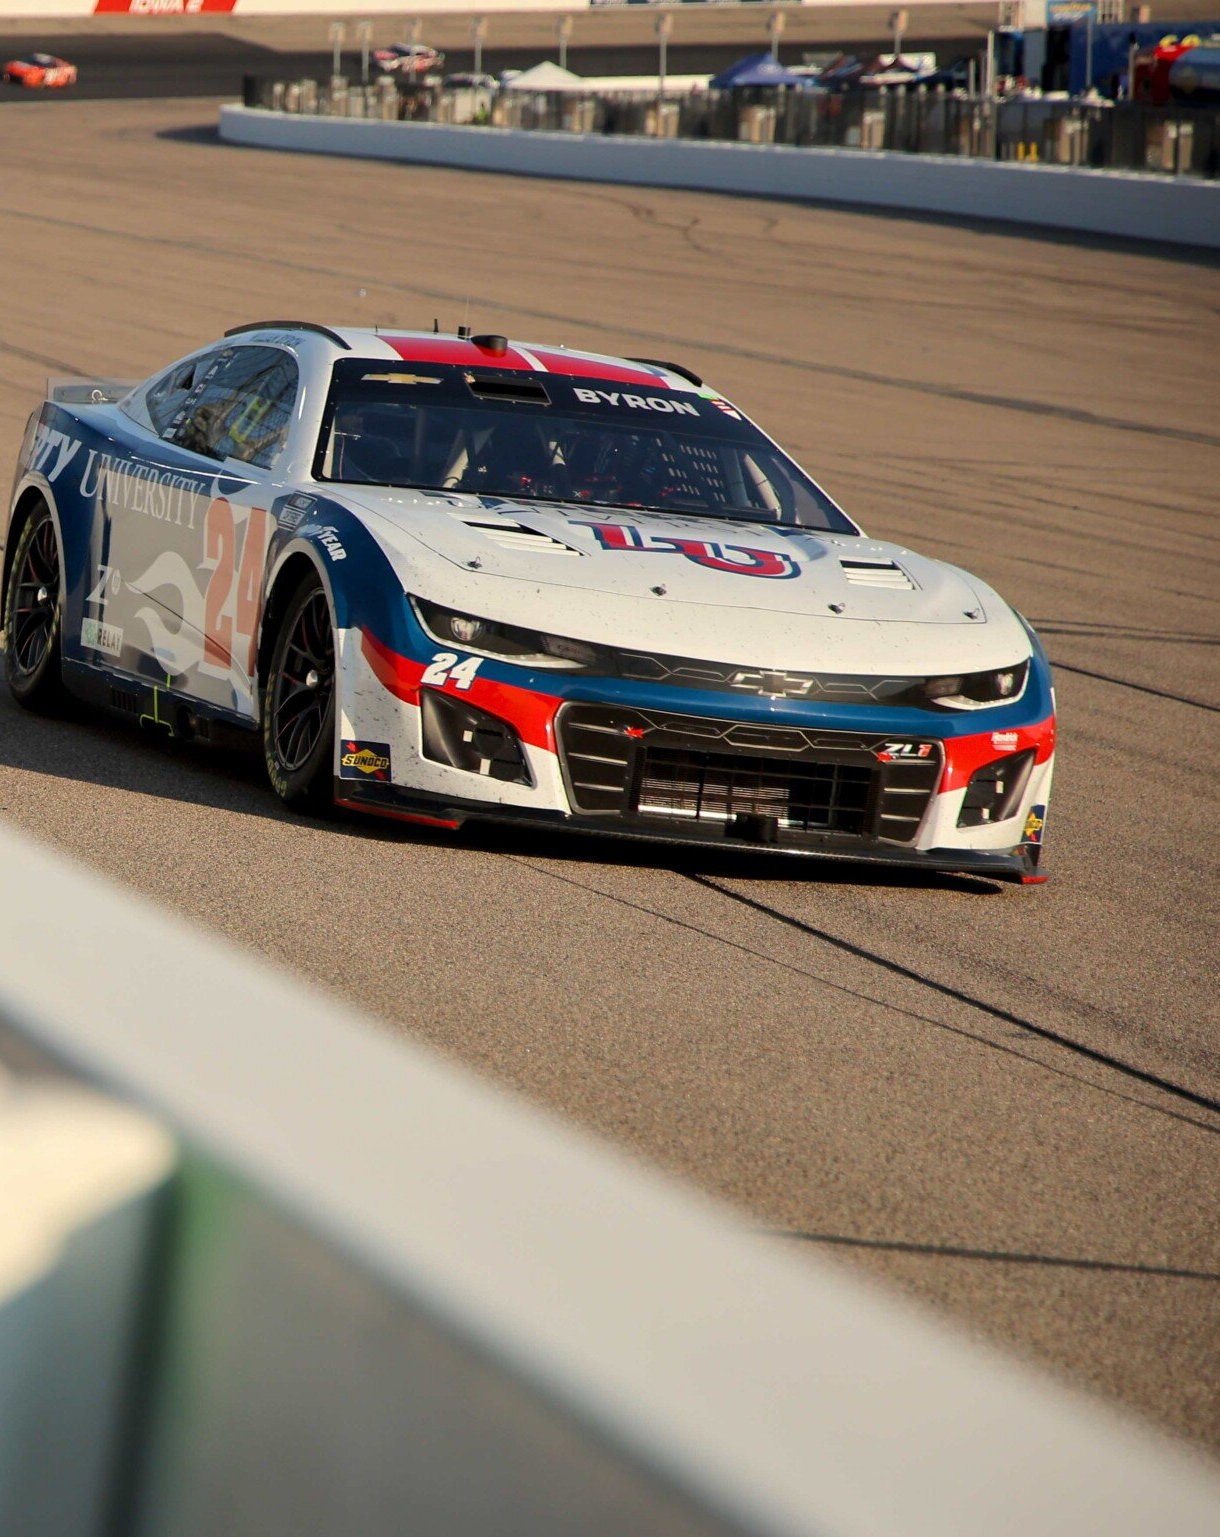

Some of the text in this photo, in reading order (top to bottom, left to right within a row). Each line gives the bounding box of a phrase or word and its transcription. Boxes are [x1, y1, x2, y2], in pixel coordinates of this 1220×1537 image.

[573, 387, 700, 417] BYRON
[79, 448, 207, 530] UNIVERSITY
[204, 496, 268, 677] 24
[97, 628, 121, 650] RELAY
[420, 652, 485, 690] 24
[344, 755, 388, 769] SUNOCO
[884, 743, 932, 757] ZL1
